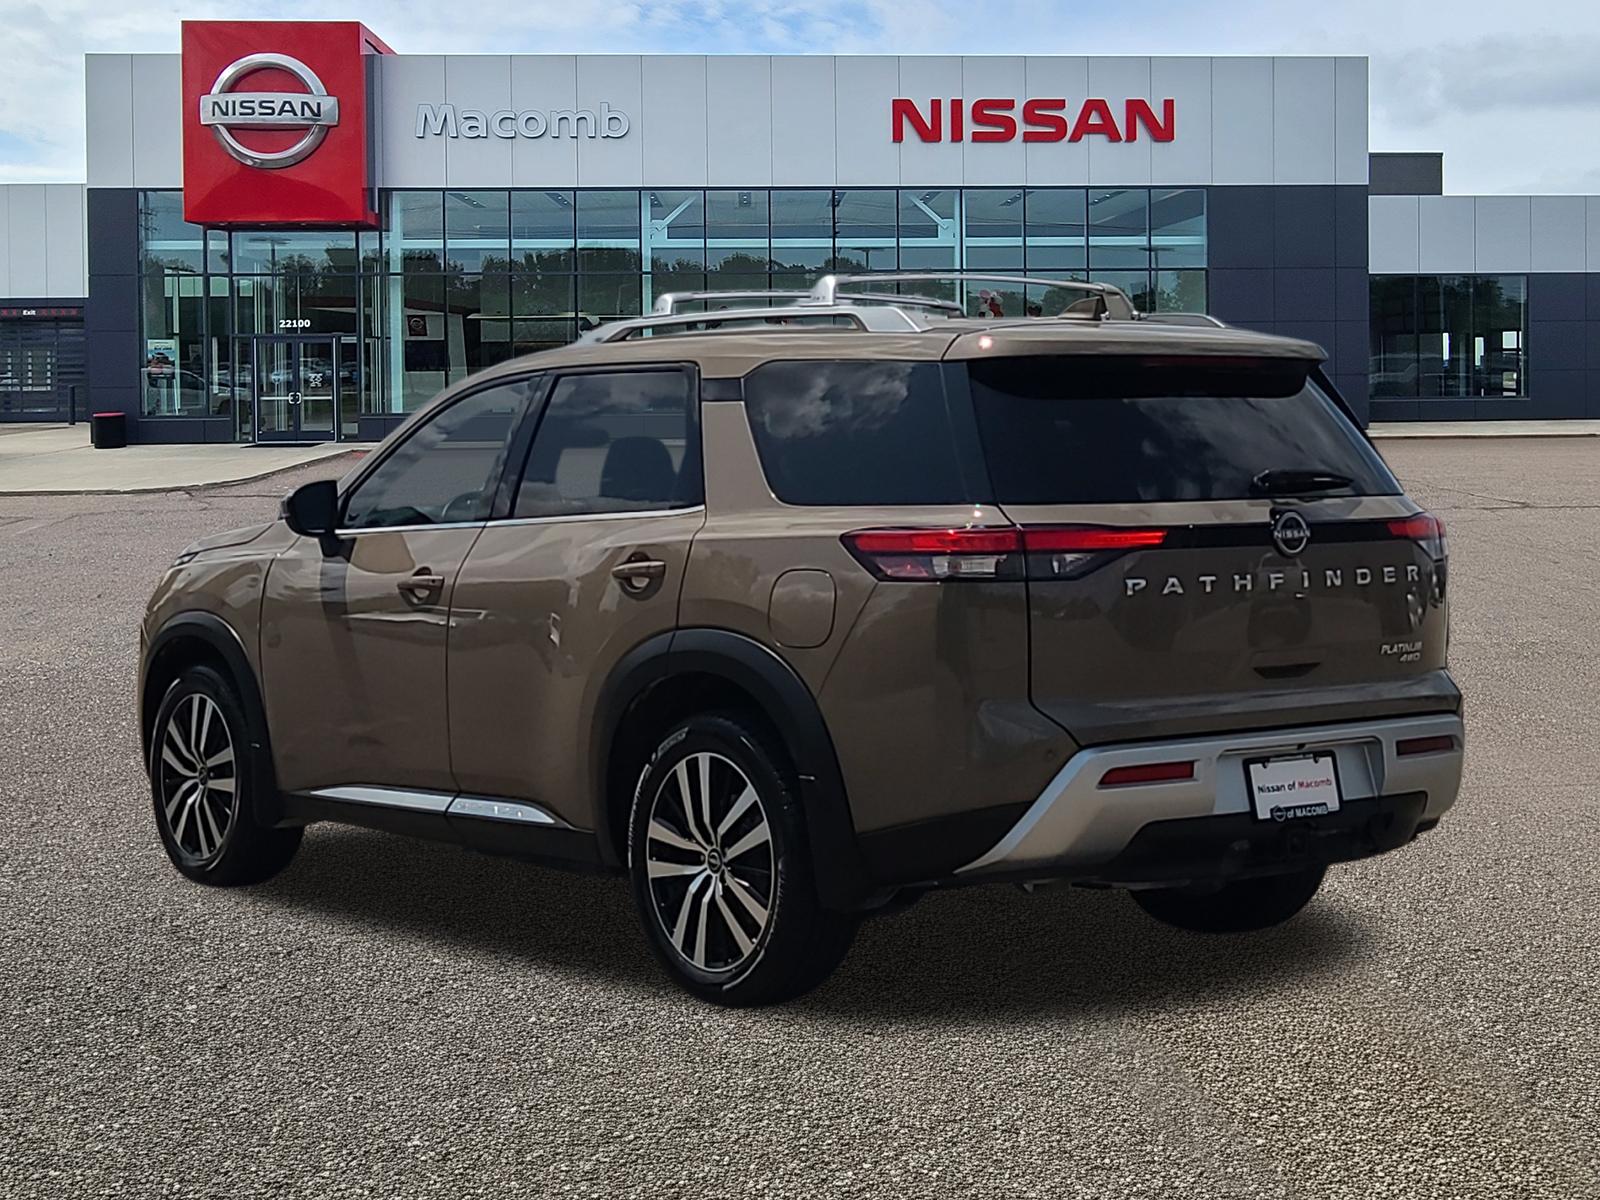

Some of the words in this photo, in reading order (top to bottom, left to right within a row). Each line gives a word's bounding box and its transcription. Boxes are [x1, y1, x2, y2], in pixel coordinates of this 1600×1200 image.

[211, 98, 322, 118] NISSAN
[415, 102, 630, 139] Macomb
[891, 98, 1176, 143] NISSAN
[279, 319, 311, 328] 22100
[1273, 529, 1311, 539] NISSAN
[1124, 564, 1421, 596] PATHFINDER
[1380, 641, 1422, 655] PLATINUM
[1257, 783, 1286, 794] Nissan
[1287, 780, 1296, 791] of
[1298, 778, 1331, 789] Macomb
[1295, 805, 1328, 817] MACOMB
